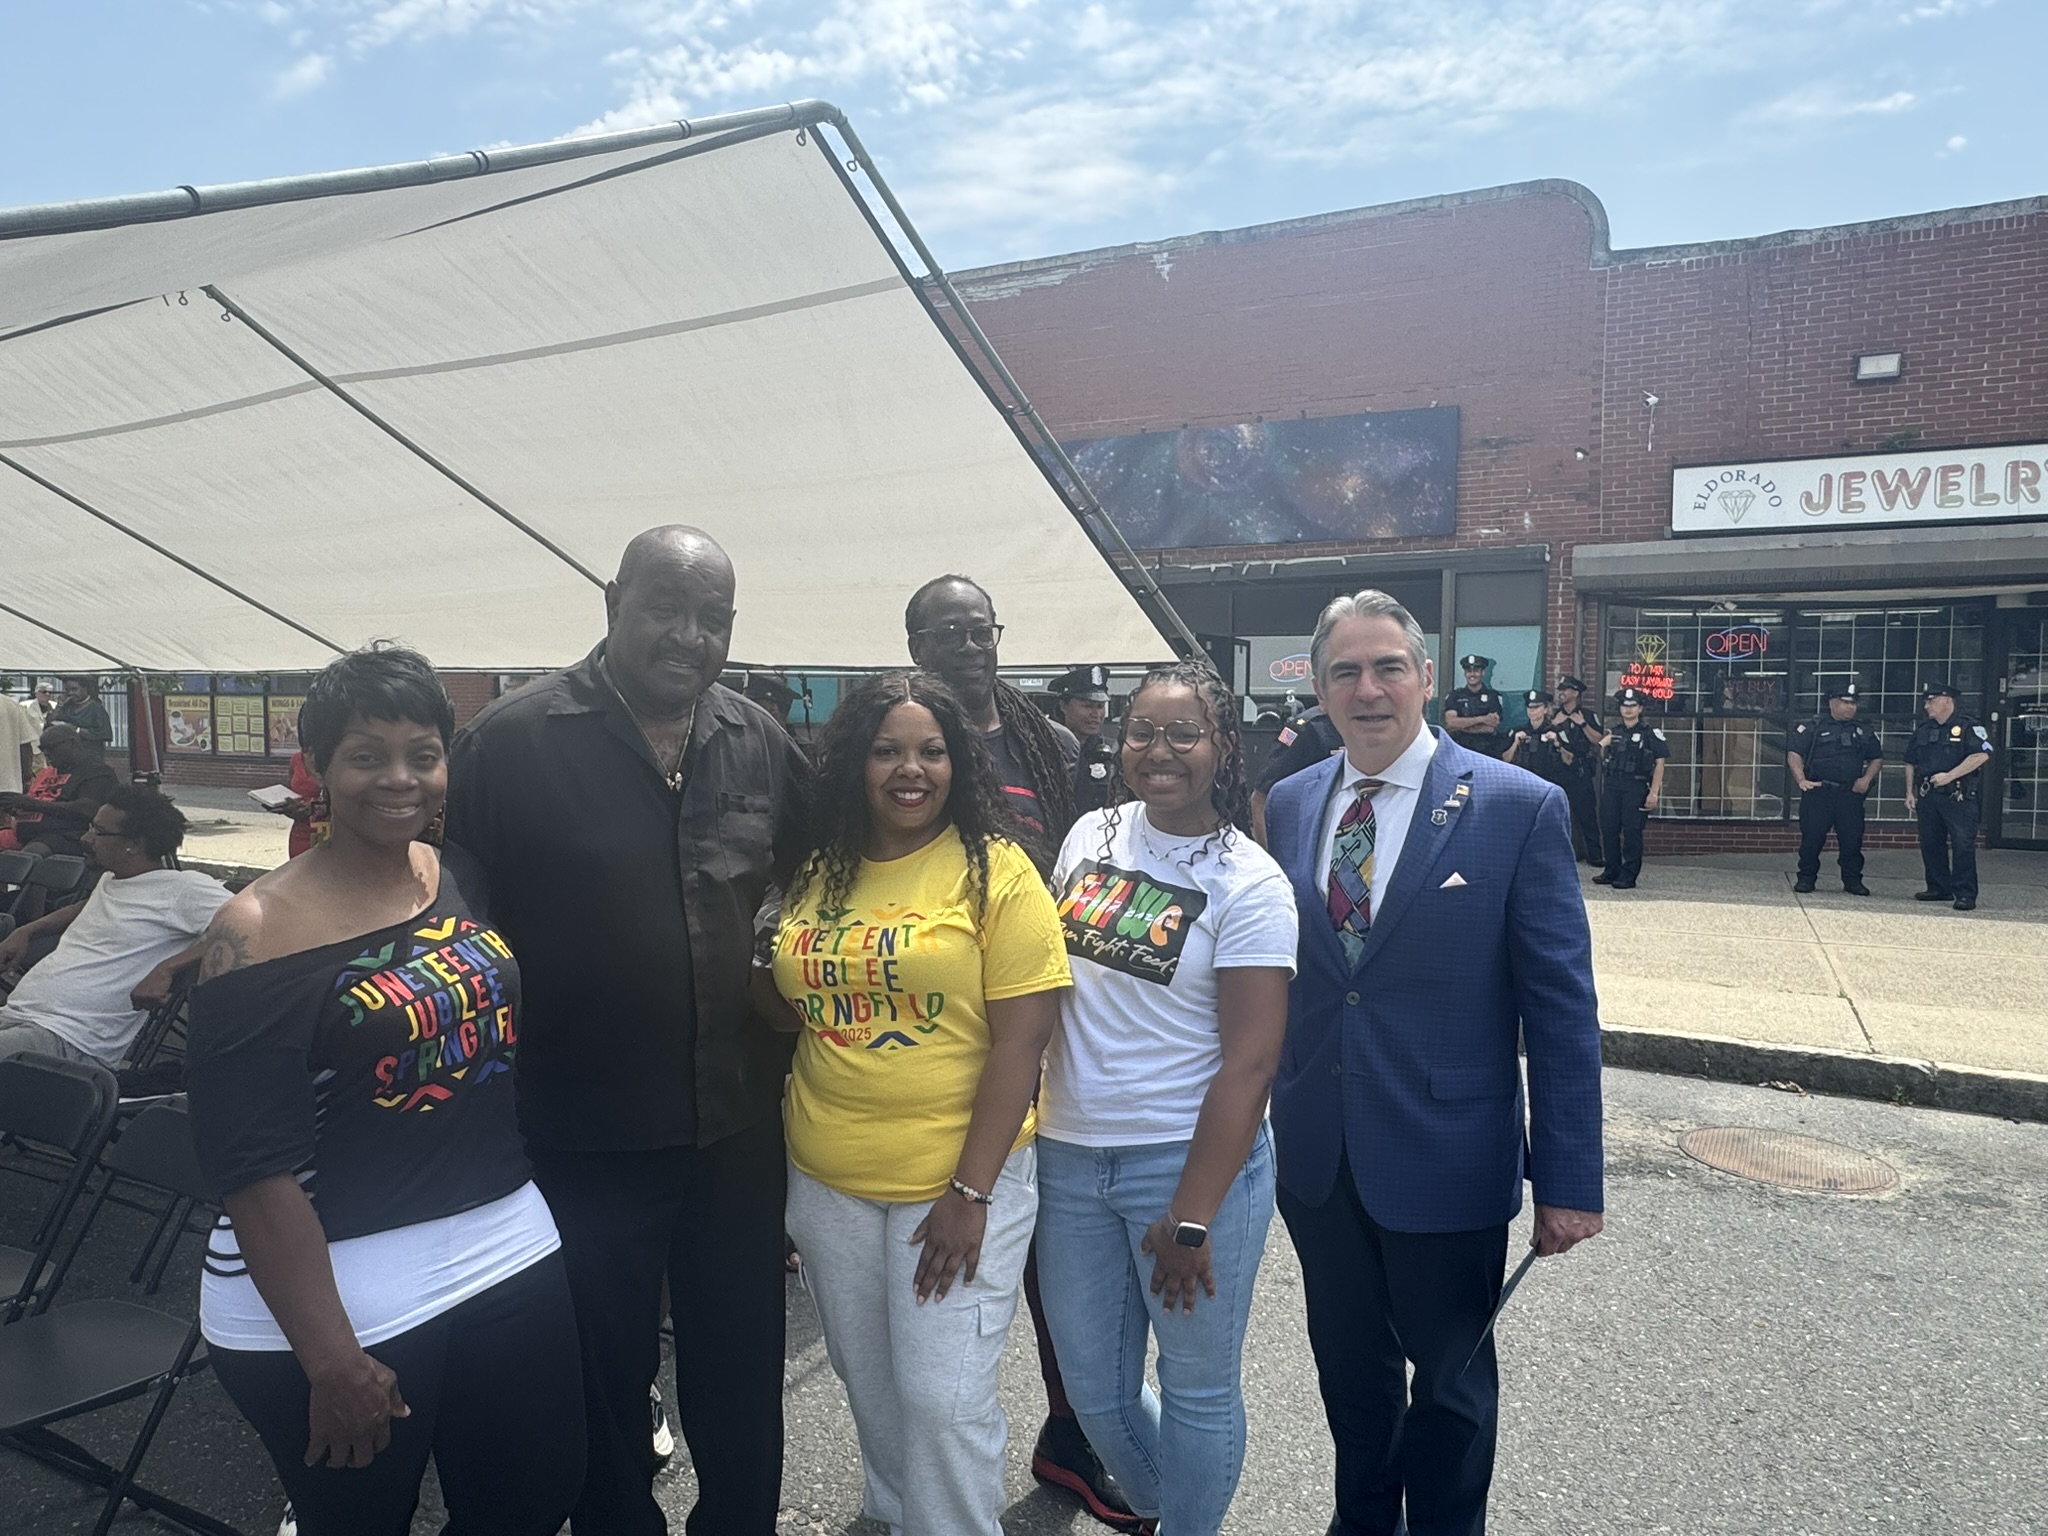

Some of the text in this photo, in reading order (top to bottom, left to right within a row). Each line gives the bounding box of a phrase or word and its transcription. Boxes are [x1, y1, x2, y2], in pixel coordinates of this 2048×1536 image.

[1693, 469, 1782, 511] ELDORADO
[1800, 459, 2048, 516] JEWELR
[1706, 633, 1768, 653] OPEN
[339, 929, 514, 1026] JUNETEENTH
[405, 968, 506, 1042] JUBILEE
